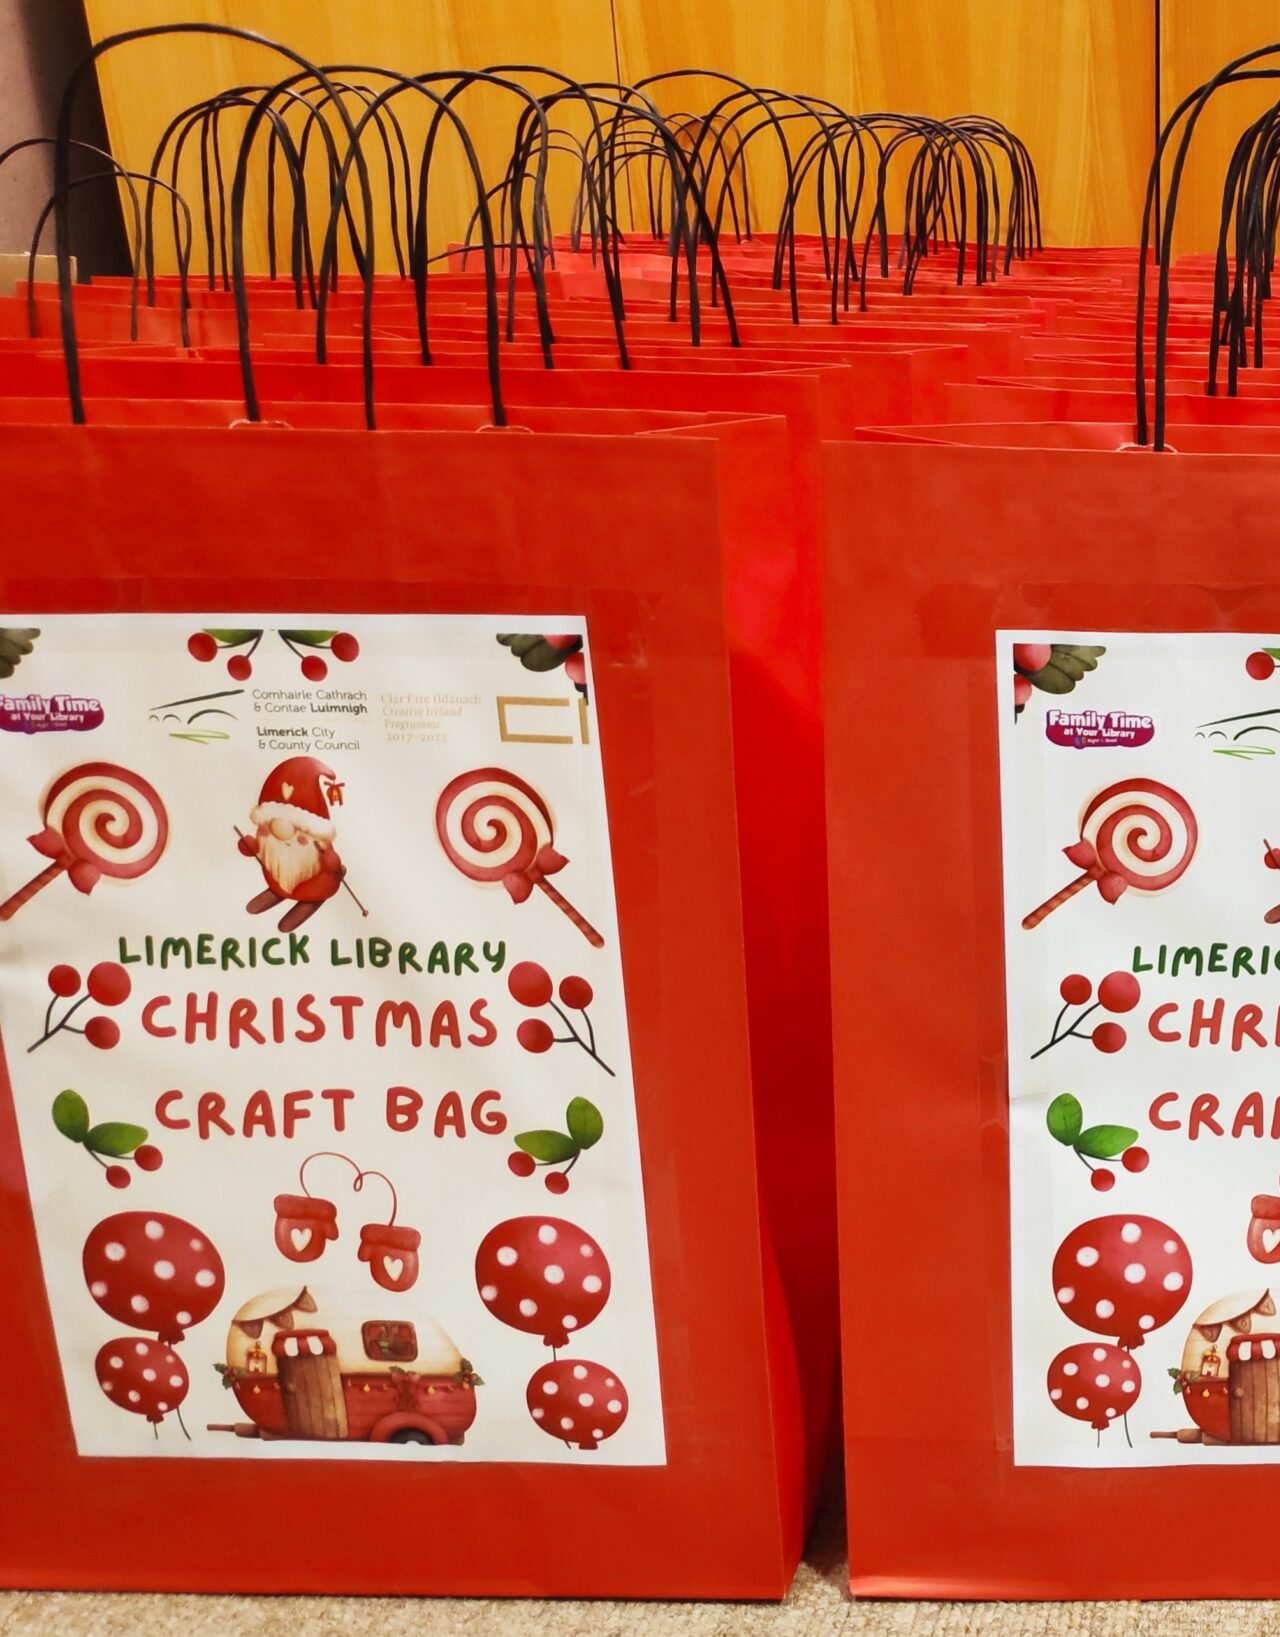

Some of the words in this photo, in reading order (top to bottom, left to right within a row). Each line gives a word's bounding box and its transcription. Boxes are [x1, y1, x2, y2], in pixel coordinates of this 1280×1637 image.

[252, 689, 313, 701] Comhairle
[316, 689, 367, 701] Cathrach
[55, 695, 100, 712] Time
[254, 703, 261, 712] &
[264, 703, 307, 713] Contae
[310, 703, 368, 716] Luimnigh
[23, 713, 46, 721] Your
[50, 713, 84, 723] Library
[1049, 710, 1106, 730] Family
[1110, 711, 1152, 728] Time
[256, 726, 308, 737] Limerick
[311, 727, 336, 739] City
[1063, 728, 1074, 736] at
[1076, 728, 1099, 736] Your
[1102, 728, 1135, 739] Library
[258, 740, 266, 750] &
[269, 740, 311, 752] County
[314, 740, 361, 751] Council
[119, 933, 311, 972] LIMERICK
[330, 937, 507, 976] LIBRARY
[141, 991, 498, 1049] CHRISTMAS
[155, 1088, 355, 1140] CRAFT
[386, 1086, 507, 1139] BAG
